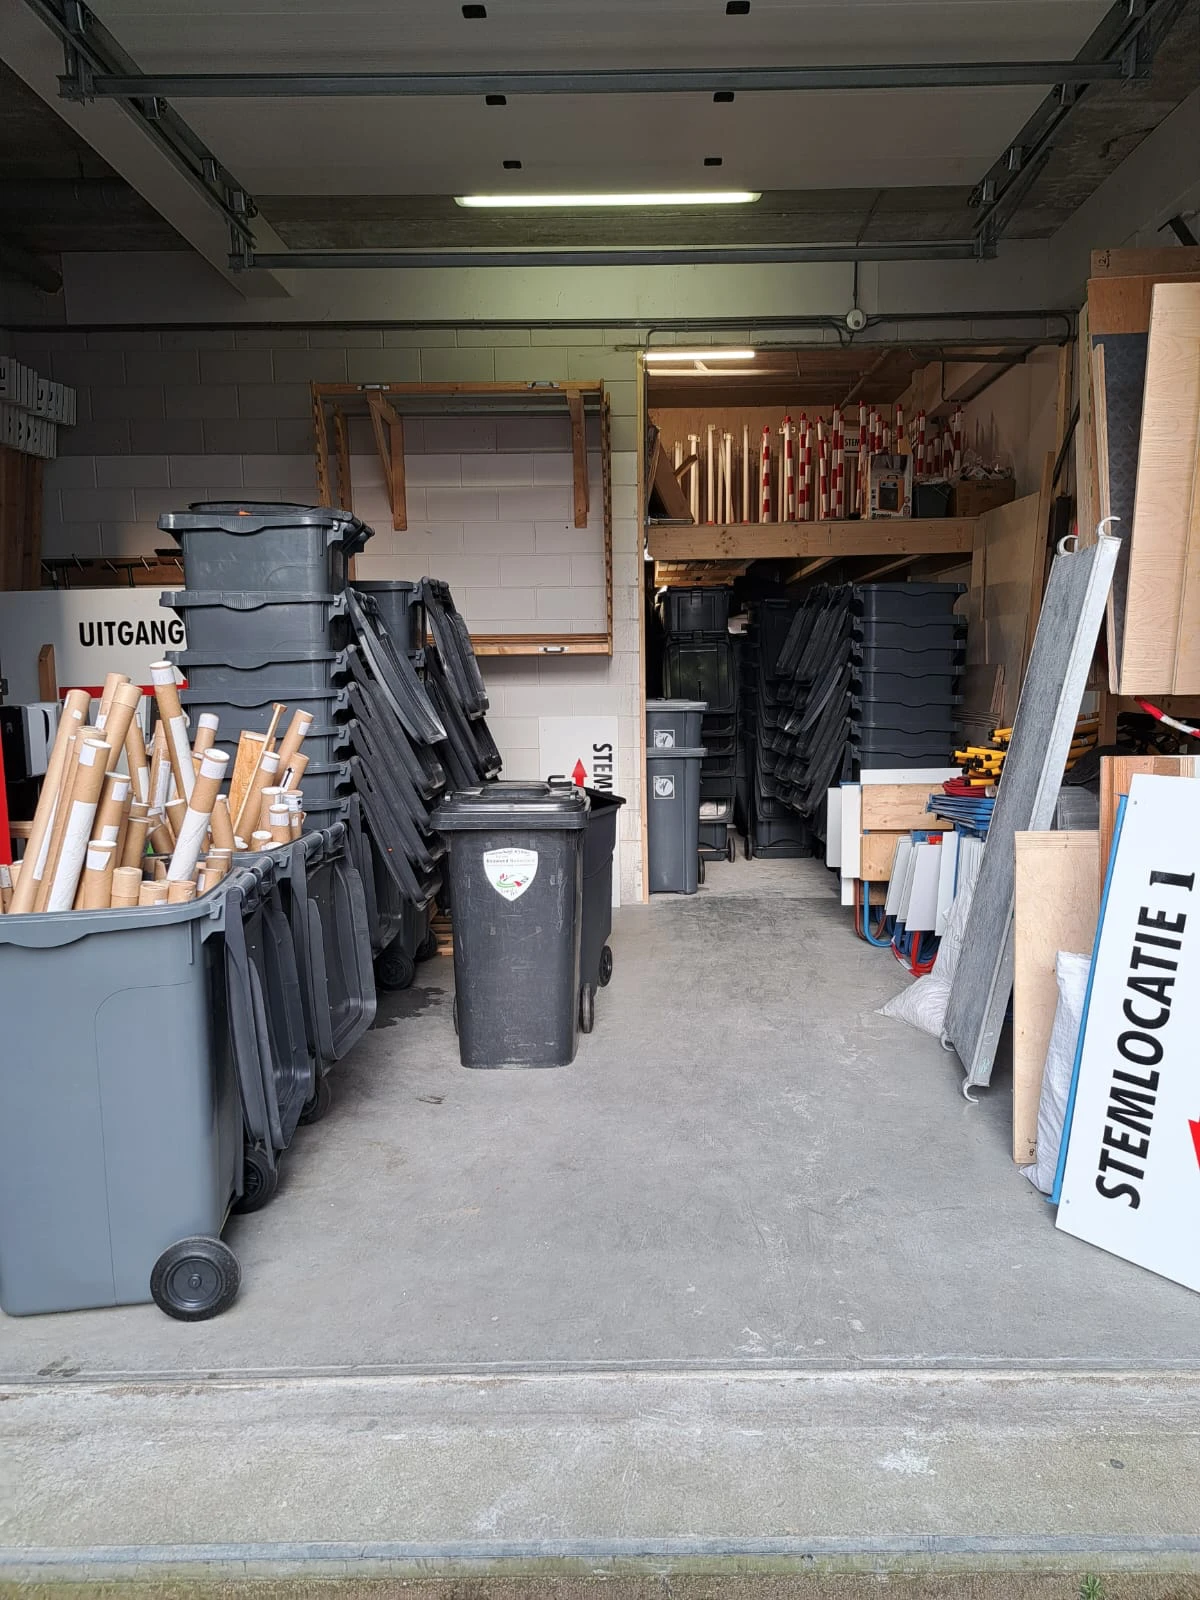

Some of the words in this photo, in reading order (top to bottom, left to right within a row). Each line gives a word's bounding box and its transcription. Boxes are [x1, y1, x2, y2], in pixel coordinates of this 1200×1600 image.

[79, 620, 185, 647] UITGANG
[592, 743, 613, 796] STEM
[1095, 906, 1187, 1210] STEMLOCATIE
